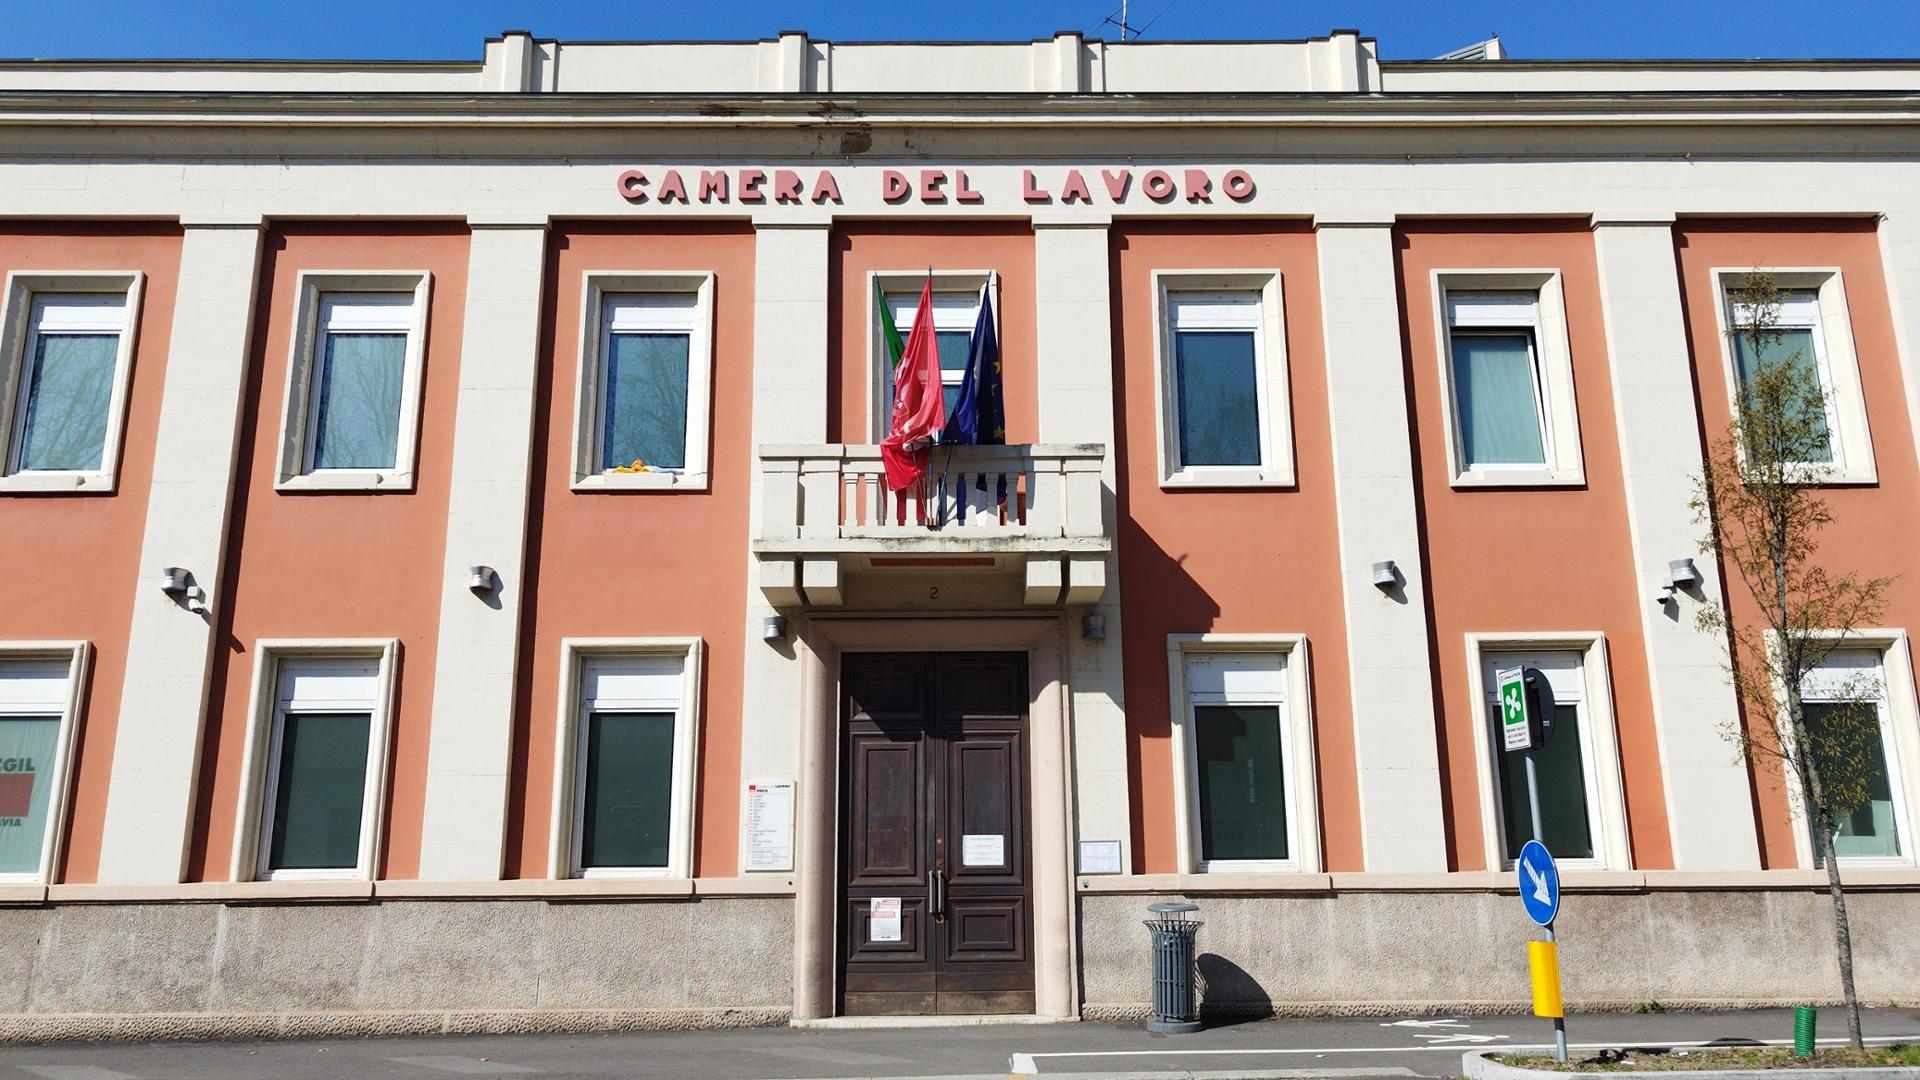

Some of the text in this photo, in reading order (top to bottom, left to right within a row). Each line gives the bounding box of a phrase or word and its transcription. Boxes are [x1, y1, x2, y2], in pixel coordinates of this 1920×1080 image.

[617, 169, 1255, 202] CAMERA DEL LAVORO
[929, 586, 939, 600] 2
[0, 758, 35, 772] GIL
[0, 818, 22, 827] VIA
